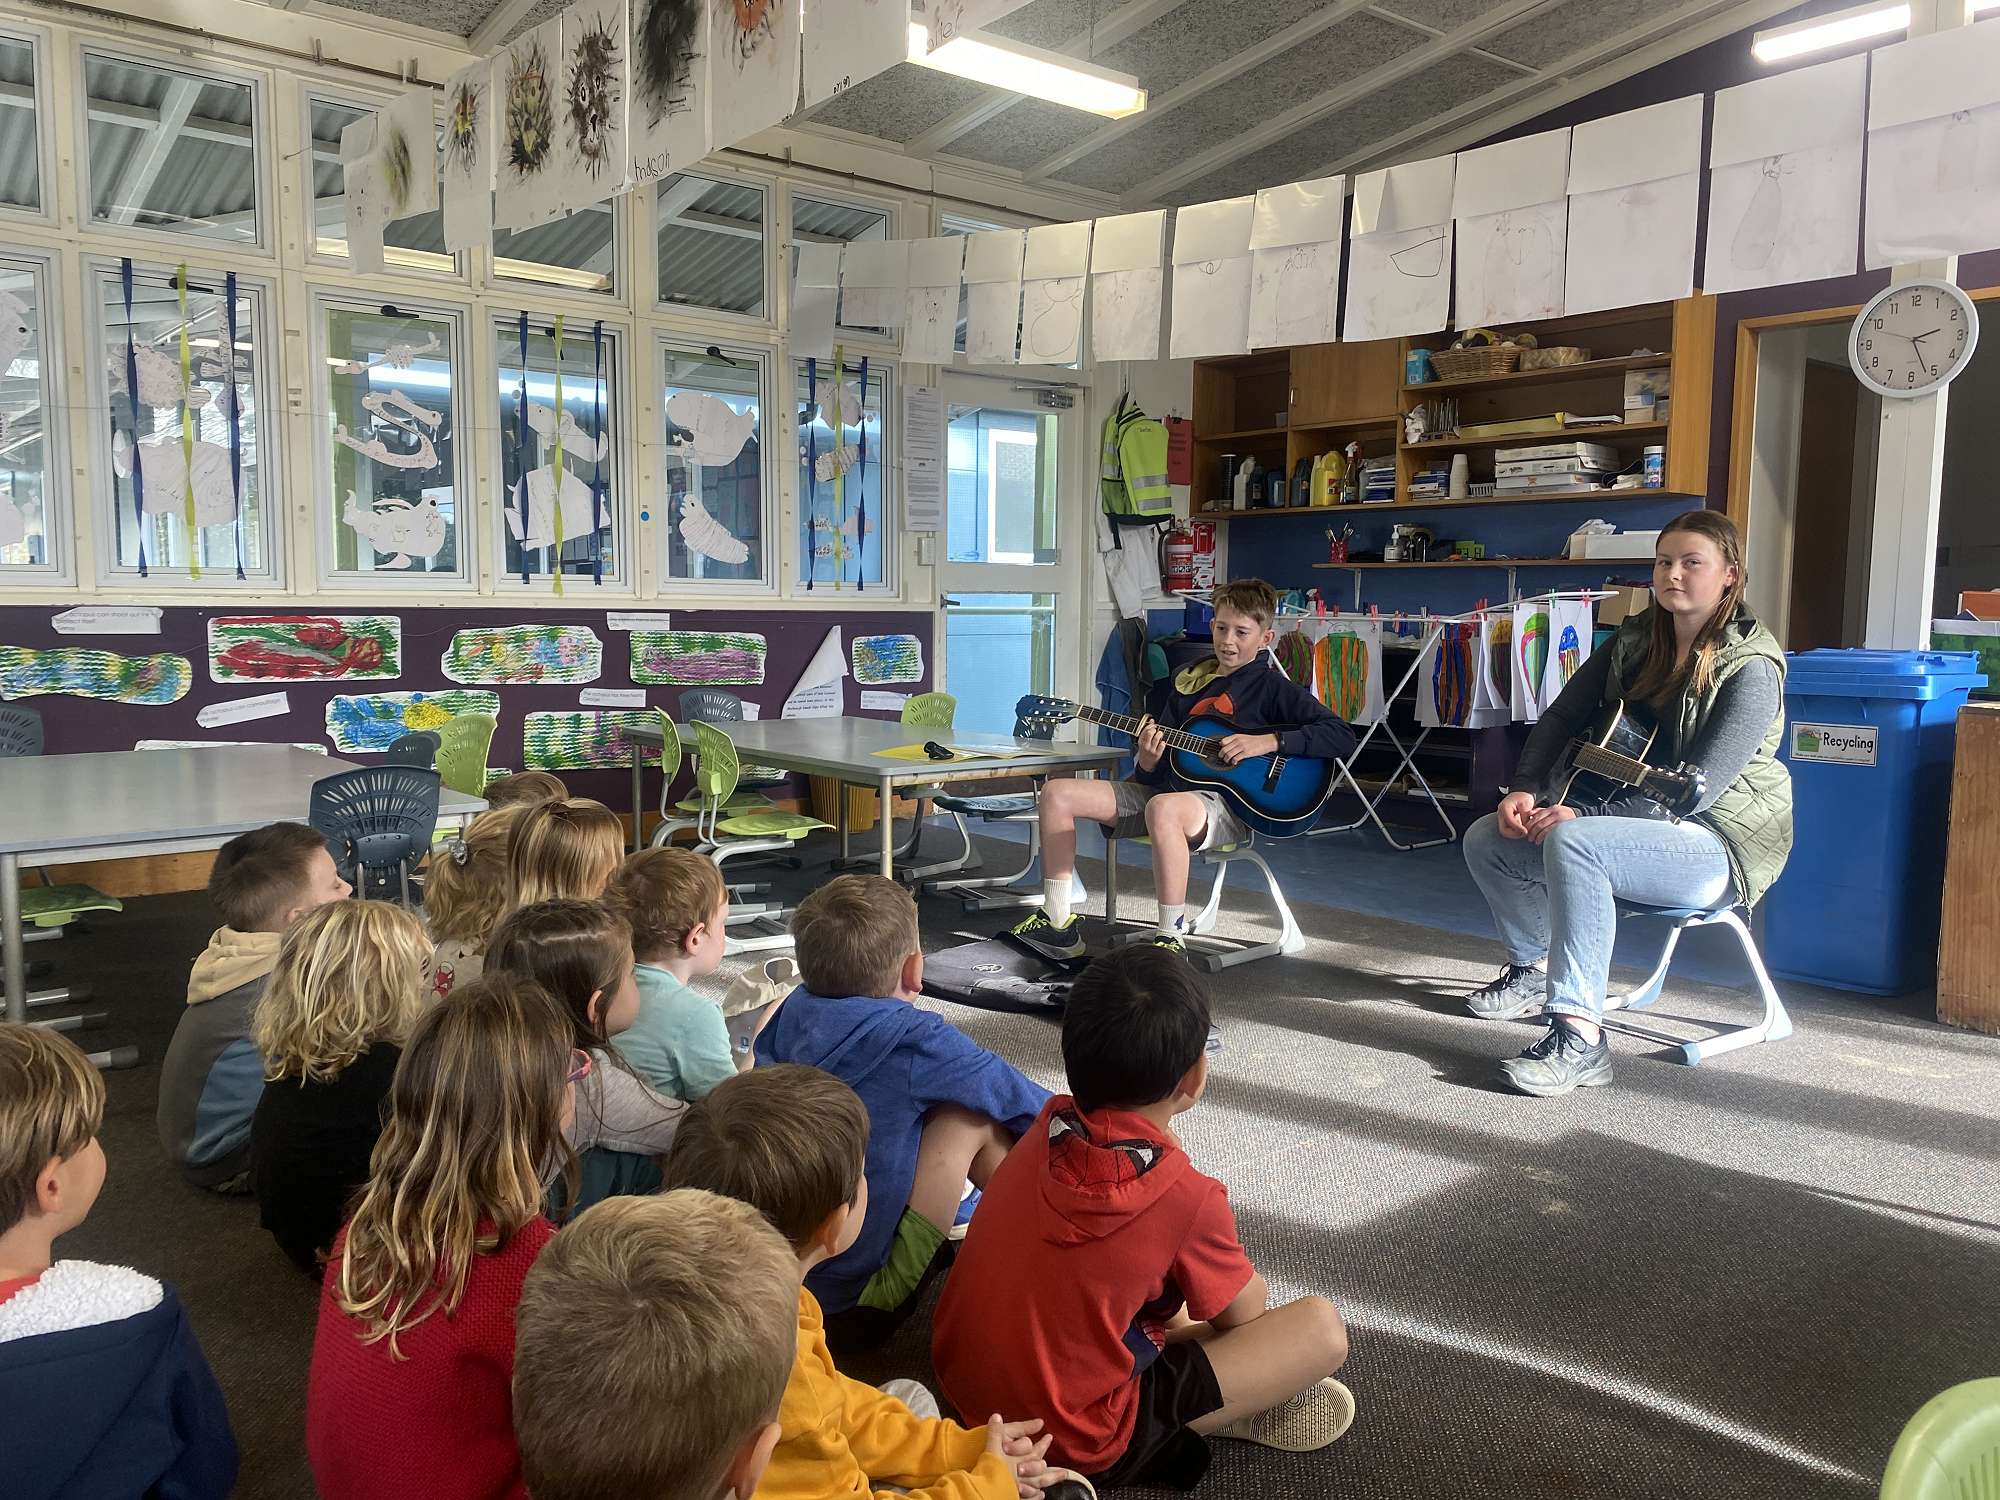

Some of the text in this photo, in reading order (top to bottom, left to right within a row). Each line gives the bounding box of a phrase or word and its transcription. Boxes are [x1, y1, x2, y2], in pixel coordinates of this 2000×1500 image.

[1911, 294, 1922, 307] 12
[1935, 297, 1940, 309] 1
[1890, 303, 1899, 315] 11
[1950, 309, 1958, 321] 2
[1873, 318, 1884, 331] 10
[1956, 329, 1964, 341] 3
[1865, 339, 1873, 351] 9
[1948, 348, 1956, 360] 4
[1872, 356, 1879, 368] 8
[1887, 369, 1894, 381] 7
[1930, 364, 1938, 377] 5
[1908, 371, 1915, 383] 6
[1823, 732, 1874, 753] Recycling
